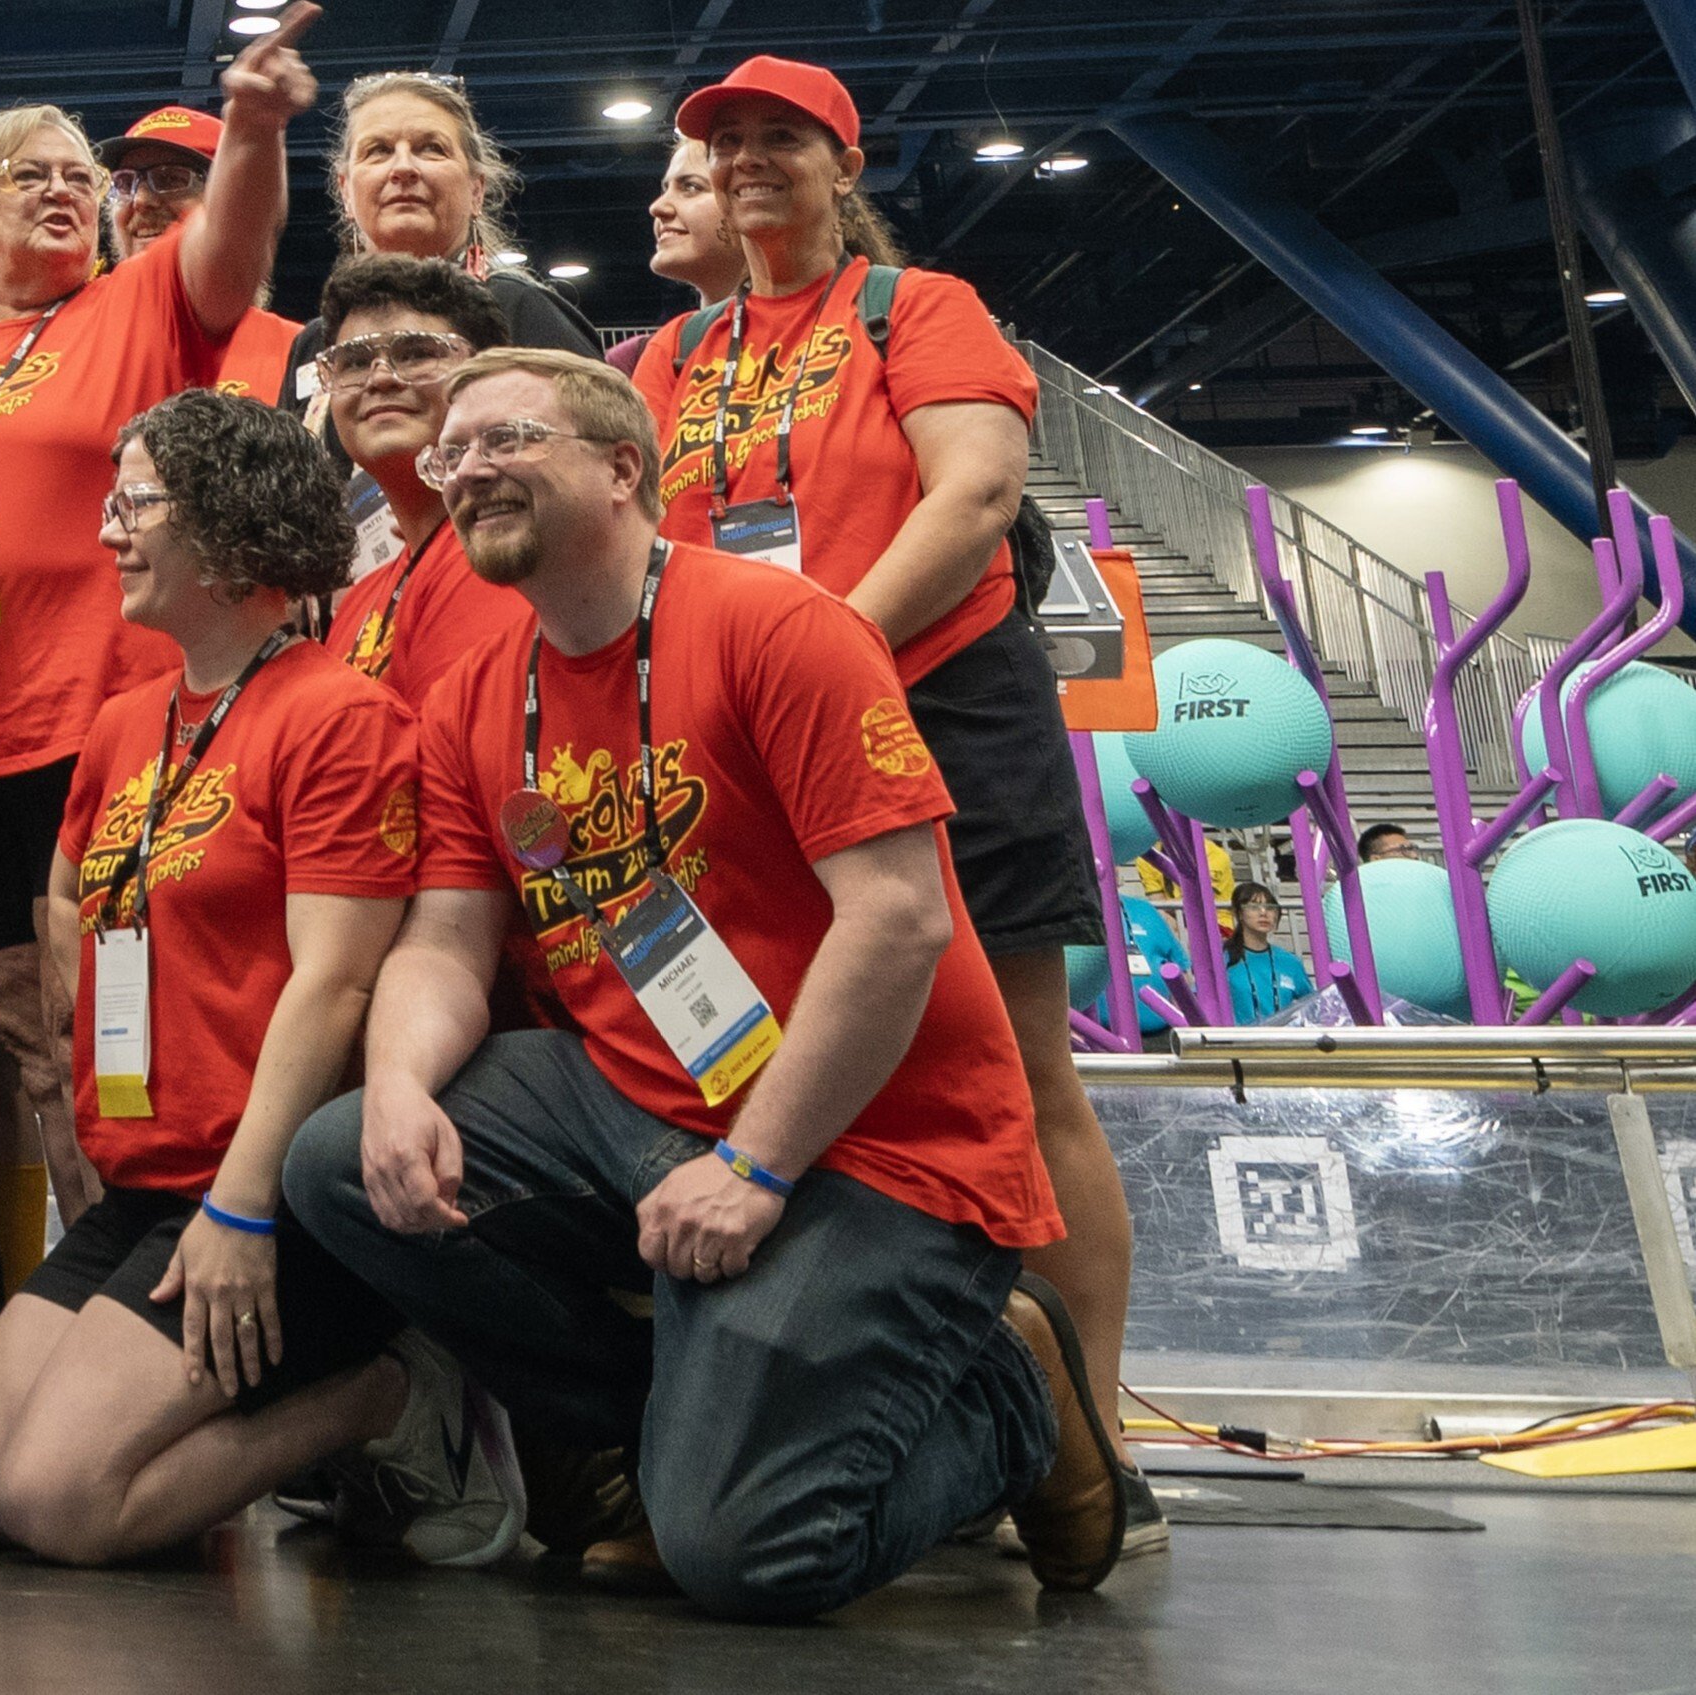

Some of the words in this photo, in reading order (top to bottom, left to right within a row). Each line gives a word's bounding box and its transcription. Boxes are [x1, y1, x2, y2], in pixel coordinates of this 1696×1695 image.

[1173, 699, 1251, 723] FIRST
[1637, 872, 1693, 897] FIRST
[658, 952, 699, 992] MICHAEL
